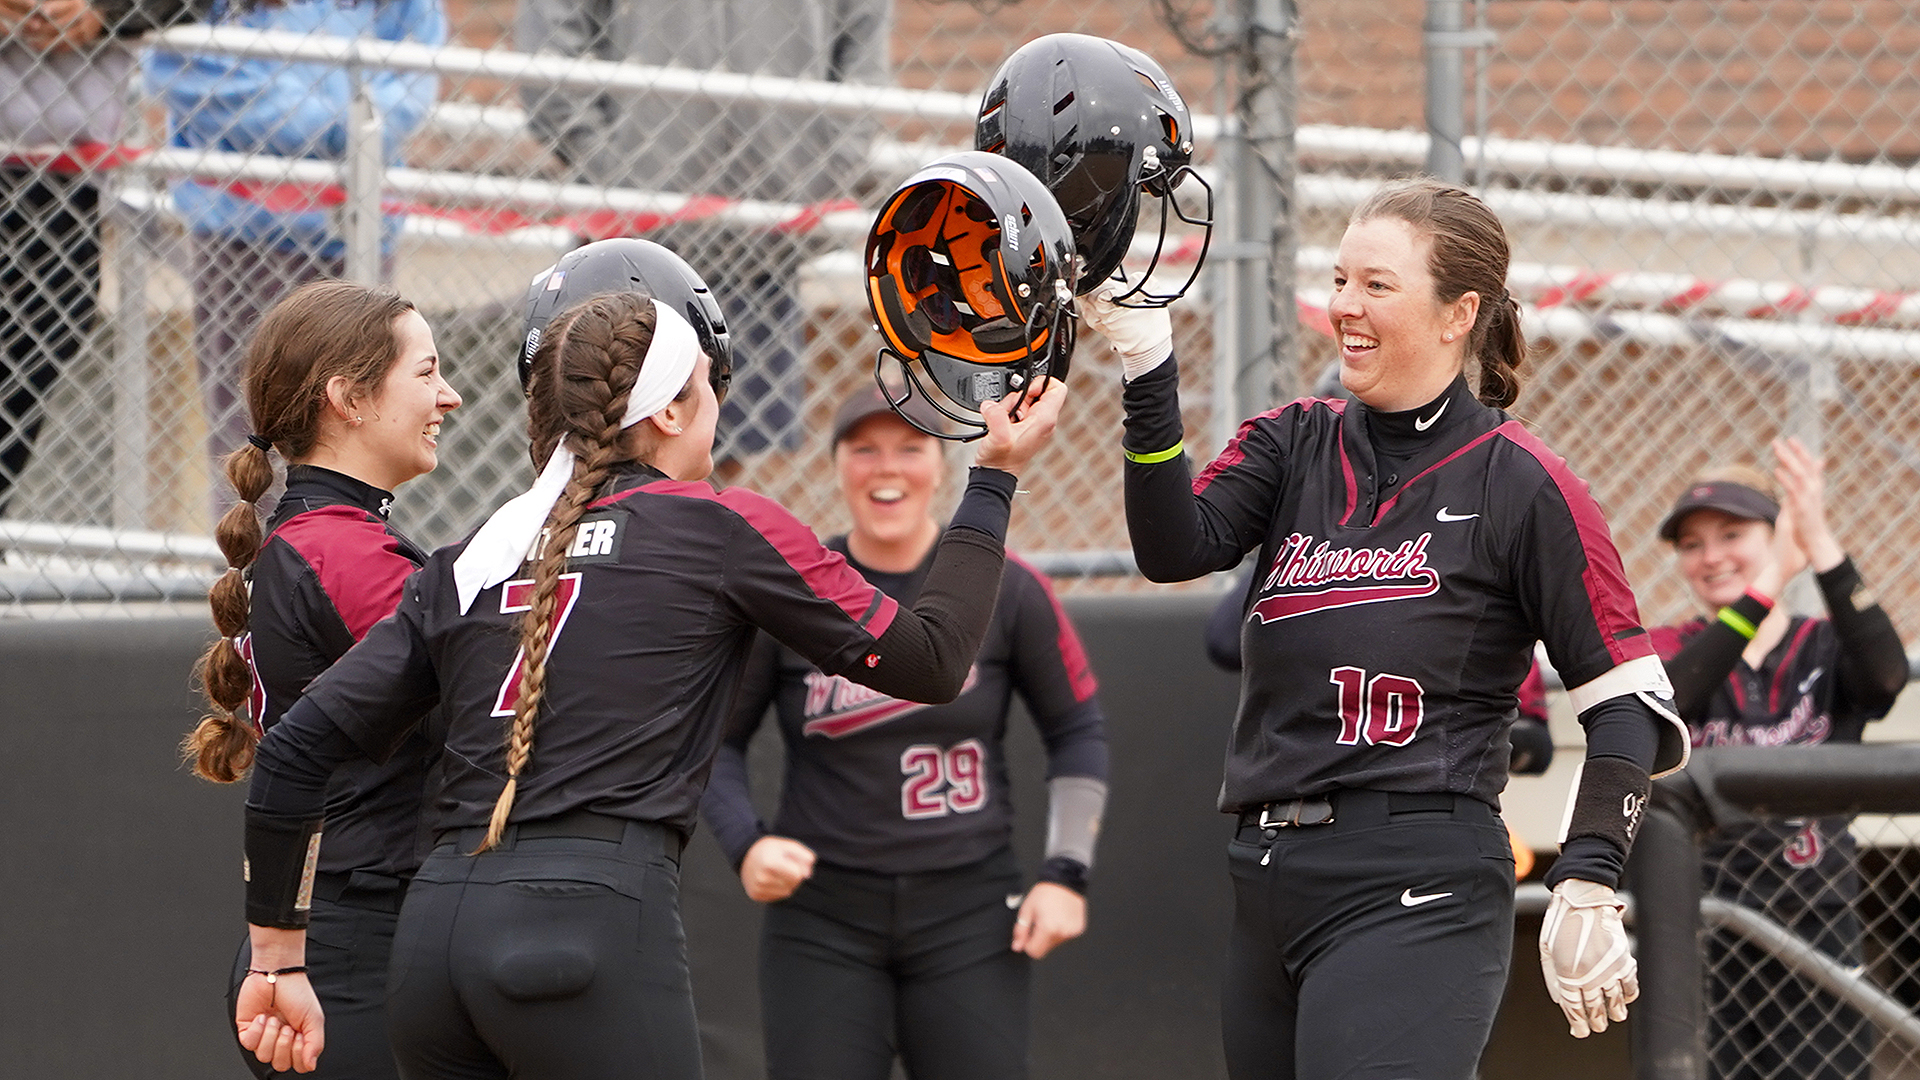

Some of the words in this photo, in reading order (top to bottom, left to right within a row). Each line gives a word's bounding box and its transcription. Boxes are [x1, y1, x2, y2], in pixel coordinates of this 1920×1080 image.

[490, 572, 583, 718] 7
[1329, 665, 1426, 748] 10
[900, 738, 989, 821] 29
